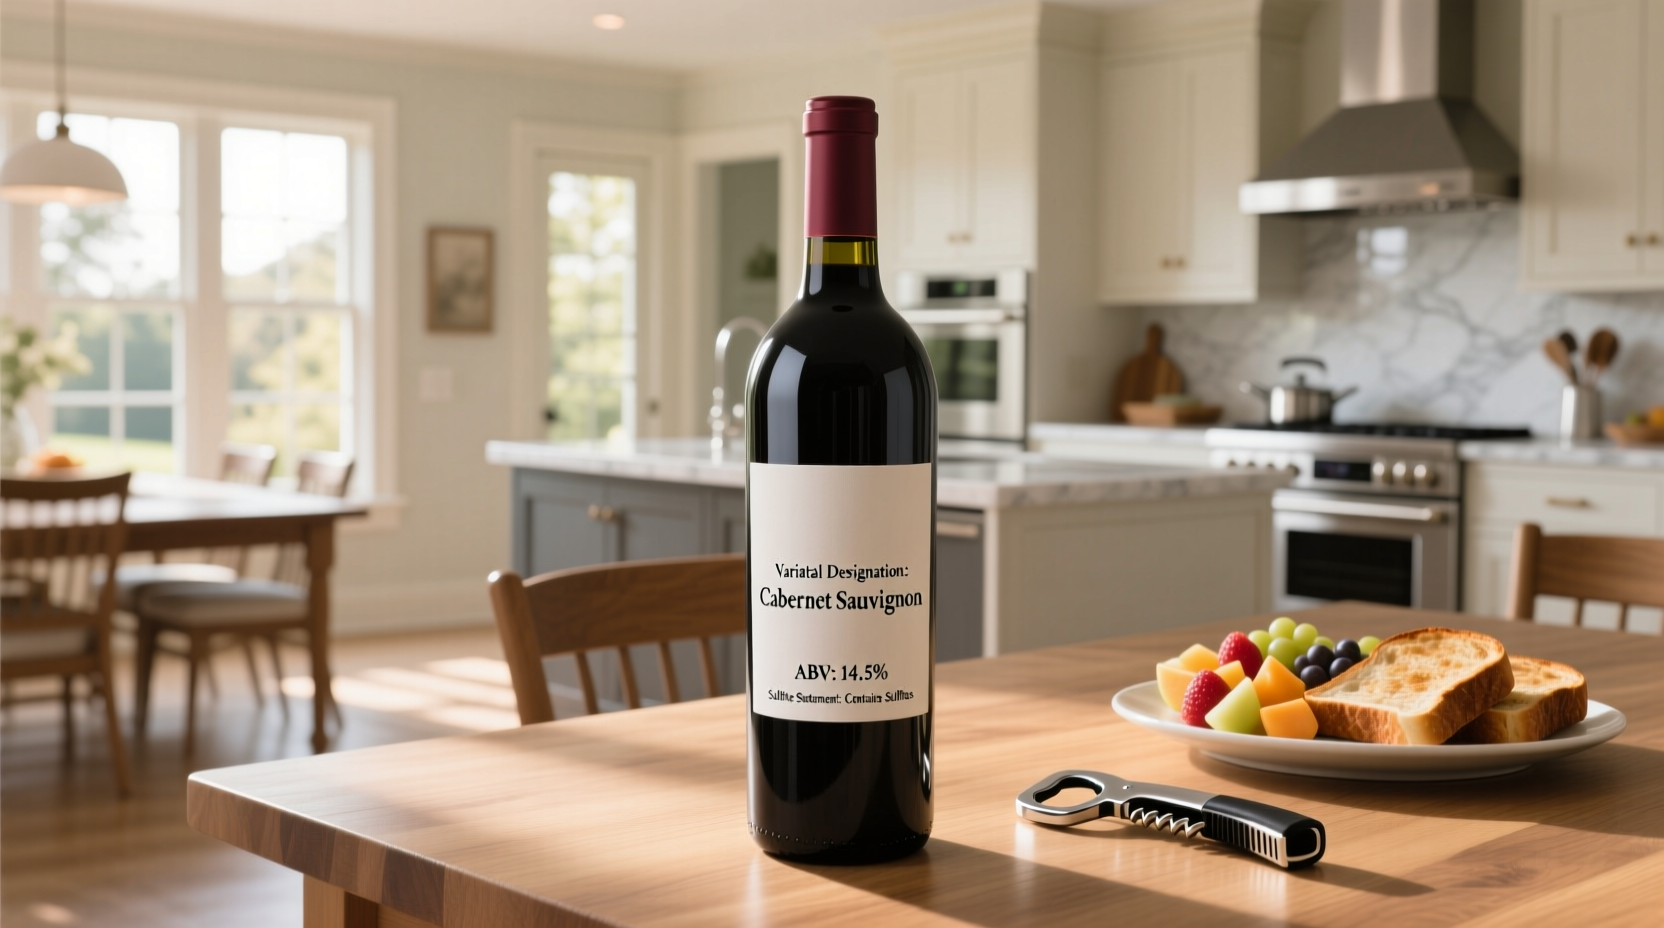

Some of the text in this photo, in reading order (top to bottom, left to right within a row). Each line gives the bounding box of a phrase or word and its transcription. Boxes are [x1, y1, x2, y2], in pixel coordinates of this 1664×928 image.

[827, 563, 909, 583] Designation:
[759, 586, 923, 616] Cabernet Sauvignon
[794, 663, 889, 682] ABV: 14.5%
